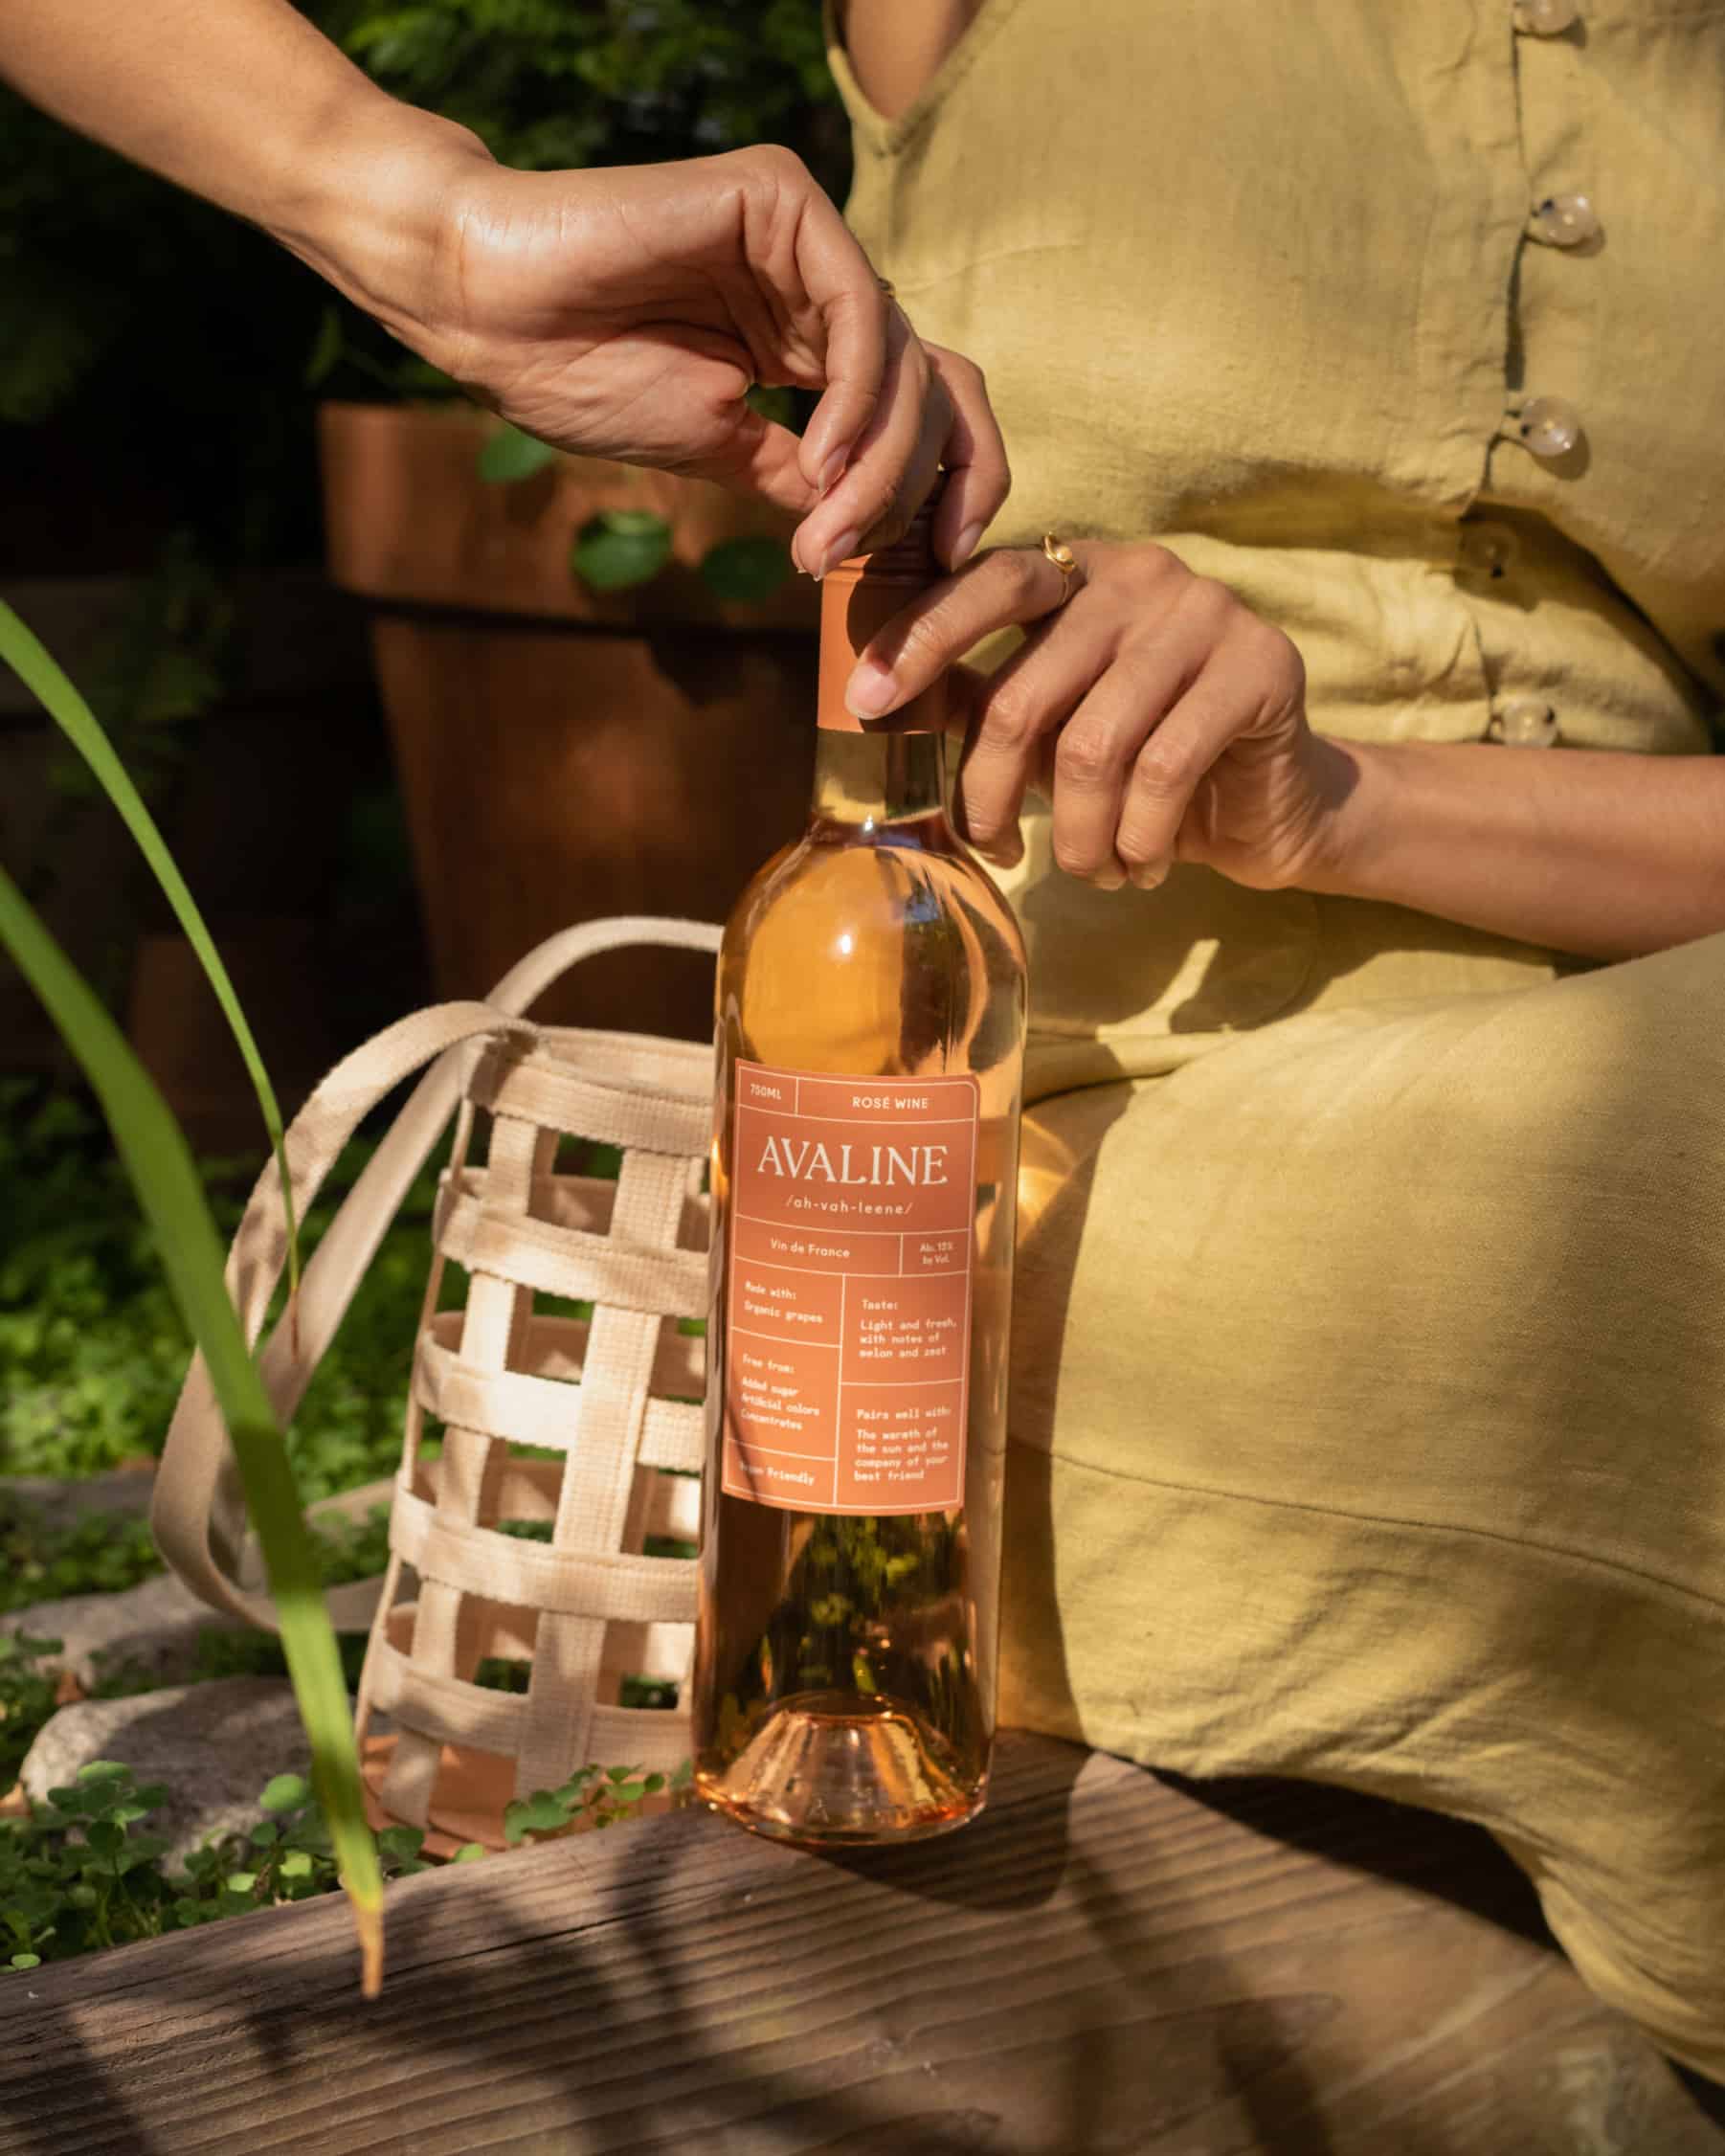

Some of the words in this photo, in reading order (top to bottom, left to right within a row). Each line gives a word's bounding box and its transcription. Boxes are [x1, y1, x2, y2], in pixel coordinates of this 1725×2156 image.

[750, 1084, 781, 1100] 750ML
[852, 1095, 889, 1109] ROSÉ
[895, 1098, 928, 1109] WINE
[757, 1136, 949, 1185] AVALINE
[786, 1196, 913, 1215] /ah-vah-leene/
[771, 1238, 787, 1251] Vin
[790, 1240, 804, 1253] de
[808, 1245, 850, 1258] France
[745, 1281, 767, 1295] Made
[770, 1288, 796, 1300] with:
[744, 1300, 780, 1318] Organic
[786, 1310, 823, 1324] grapes
[861, 1319, 893, 1331] Light
[900, 1319, 920, 1330] and
[860, 1333, 885, 1344] with
[892, 1335, 922, 1343] notes
[929, 1333, 939, 1342] of
[860, 1347, 893, 1358] melon
[900, 1346, 919, 1358] and
[742, 1354, 763, 1368] Free
[768, 1359, 795, 1374] from:
[742, 1377, 767, 1390] Added
[771, 1384, 799, 1398] sugar
[741, 1393, 781, 1411] Artificial
[786, 1401, 820, 1416] colors
[741, 1408, 803, 1430] Concentrates
[857, 1408, 888, 1420] Pairs
[895, 1408, 920, 1419] well
[857, 1428, 876, 1440] The
[883, 1429, 920, 1439] warmth
[926, 1427, 937, 1438] of
[857, 1443, 876, 1453] the
[882, 1444, 902, 1453] sun
[907, 1442, 927, 1452] and
[931, 1441, 949, 1450] the
[854, 1458, 901, 1469] company
[907, 1456, 919, 1467] of
[926, 1455, 949, 1467] your
[767, 1467, 815, 1485] Friendly
[854, 1471, 881, 1481] best
[888, 1471, 925, 1480] friend
